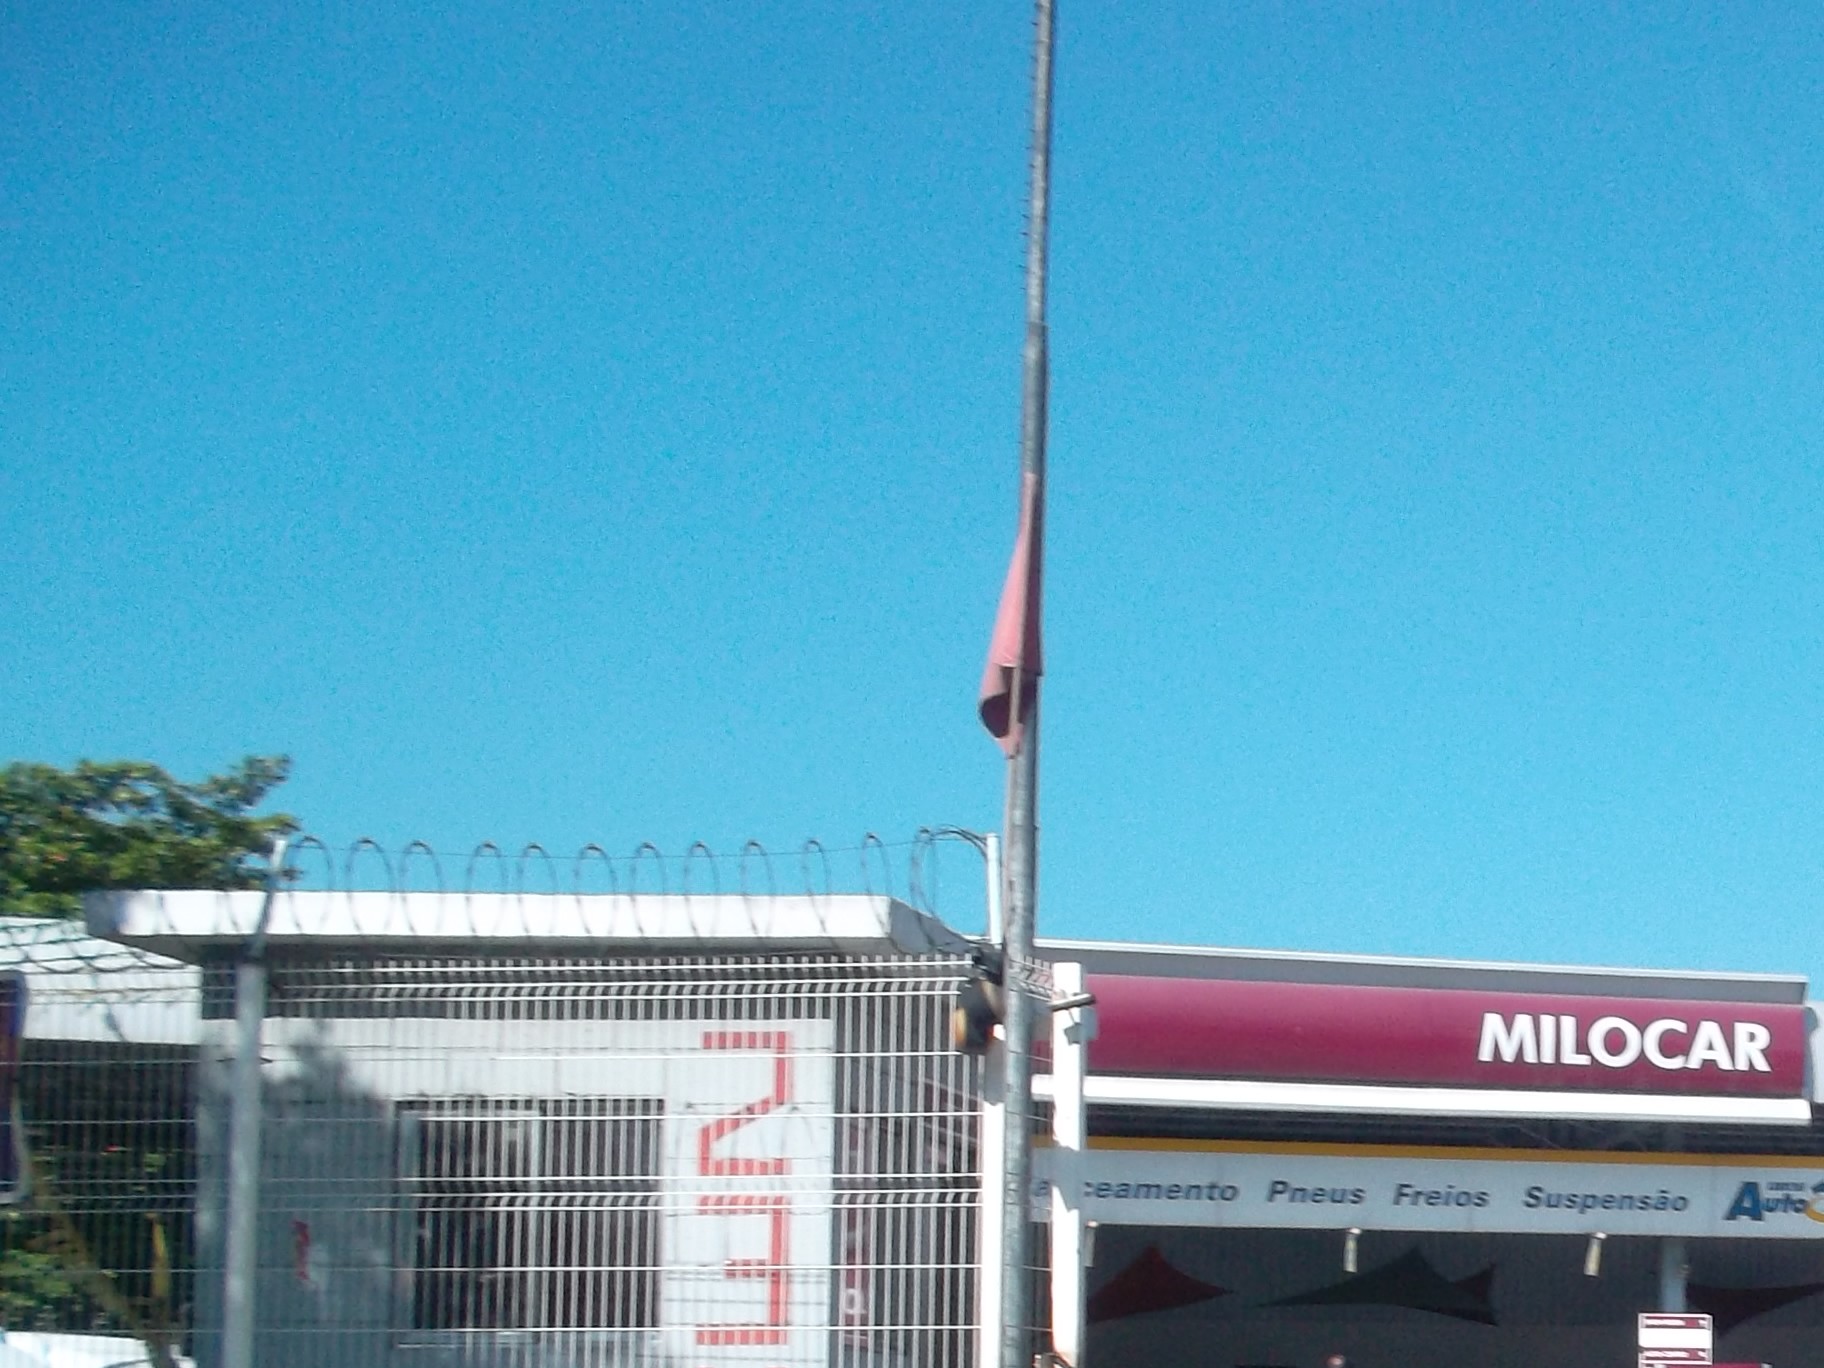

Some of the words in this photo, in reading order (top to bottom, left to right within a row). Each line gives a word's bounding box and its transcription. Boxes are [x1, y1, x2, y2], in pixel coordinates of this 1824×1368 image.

[1477, 1012, 1772, 1072] MILOCAR
[1268, 1180, 1366, 1204] Pneus
[1393, 1182, 1490, 1208] Freios
[1522, 1186, 1690, 1214] Suspensão
